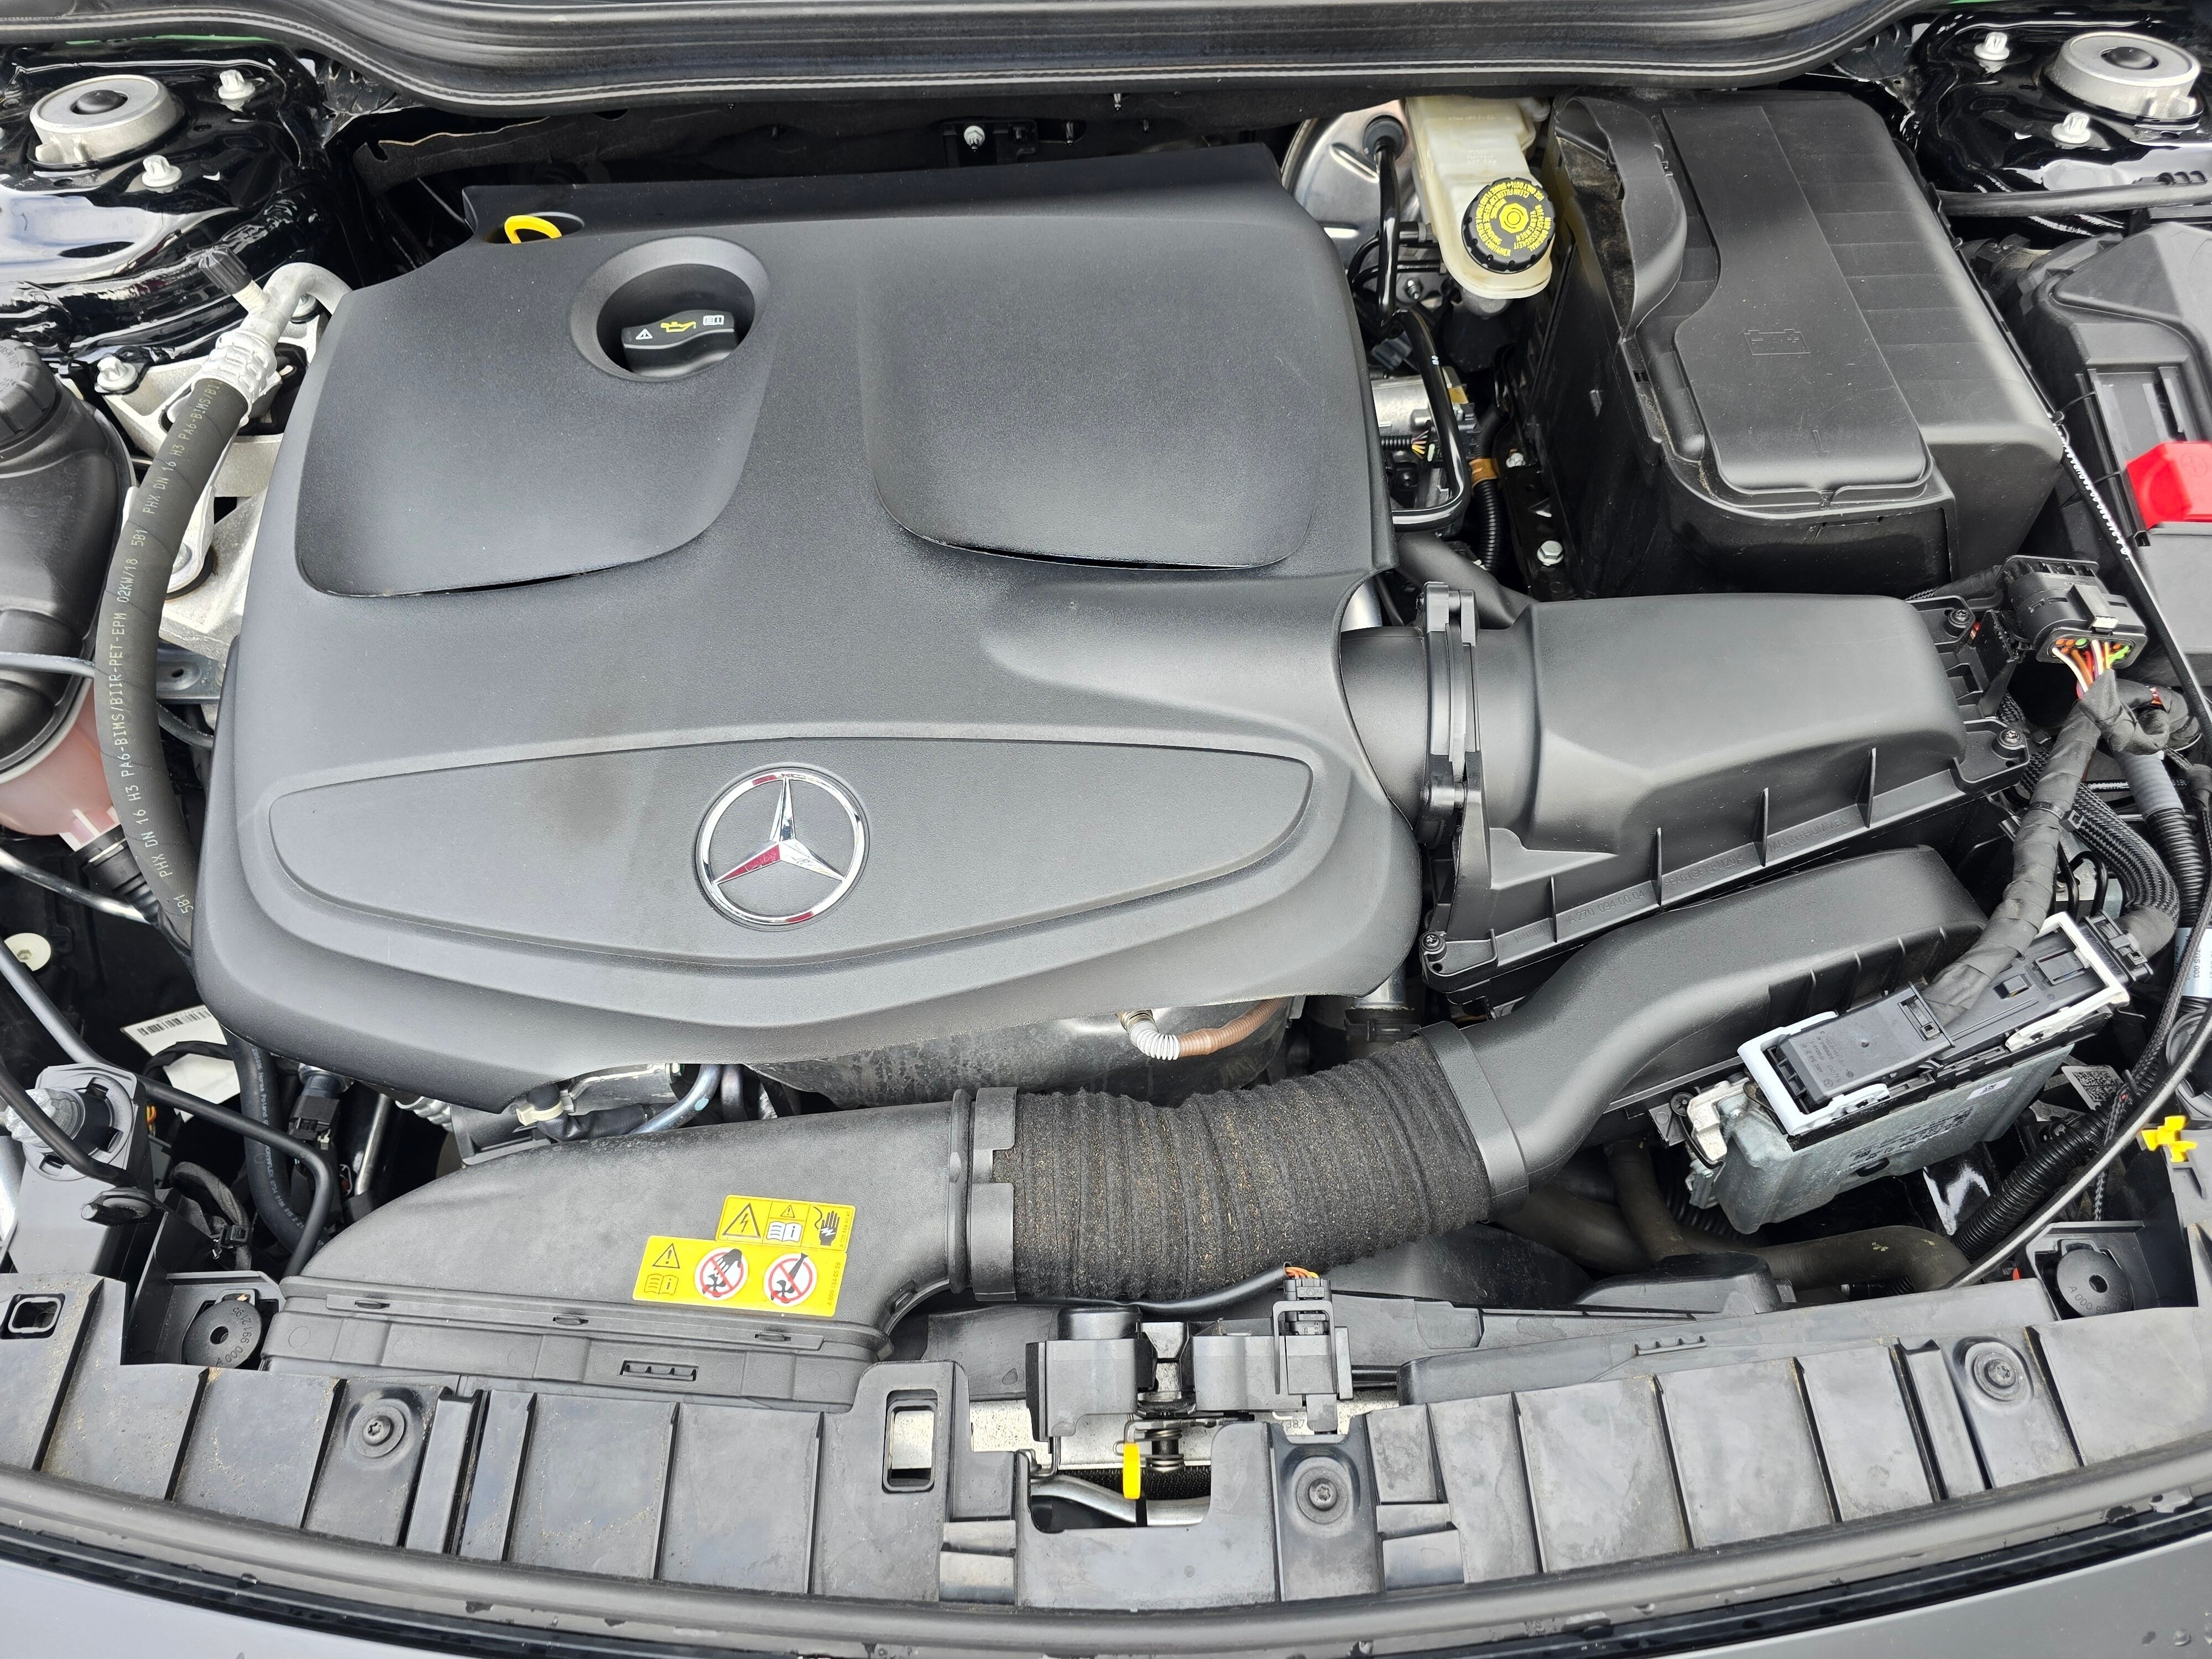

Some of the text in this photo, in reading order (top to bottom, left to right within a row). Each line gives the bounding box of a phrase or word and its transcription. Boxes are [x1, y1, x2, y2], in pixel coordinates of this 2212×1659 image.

[1490, 182, 1507, 194] BRAKE
[1498, 189, 1513, 199] FILLER
[1514, 189, 1530, 199] CLEAN
[1524, 183, 1536, 195] ONLY
[1534, 191, 1544, 201] USE
[1476, 204, 1484, 220] FROM
[1475, 223, 1488, 240] SEALED
[1483, 222, 1502, 246] REMOVING
[1516, 211, 1537, 242] VERWENDEN
[1485, 239, 1511, 257] CONTAINER
[1527, 229, 1548, 252] ORIGINAL
[169, 444, 185, 456] H3
[153, 477, 170, 490] DN
[142, 494, 160, 514] PHX
[131, 529, 148, 546] 5B1
[125, 784, 142, 802] H3
[133, 808, 149, 825] 16
[140, 831, 159, 848] DN
[151, 853, 173, 878] PHX
[1568, 890, 1646, 924] A 270 094 00 04
[2074, 1294, 2093, 1310] 000
[225, 1345, 243, 1363] 000
